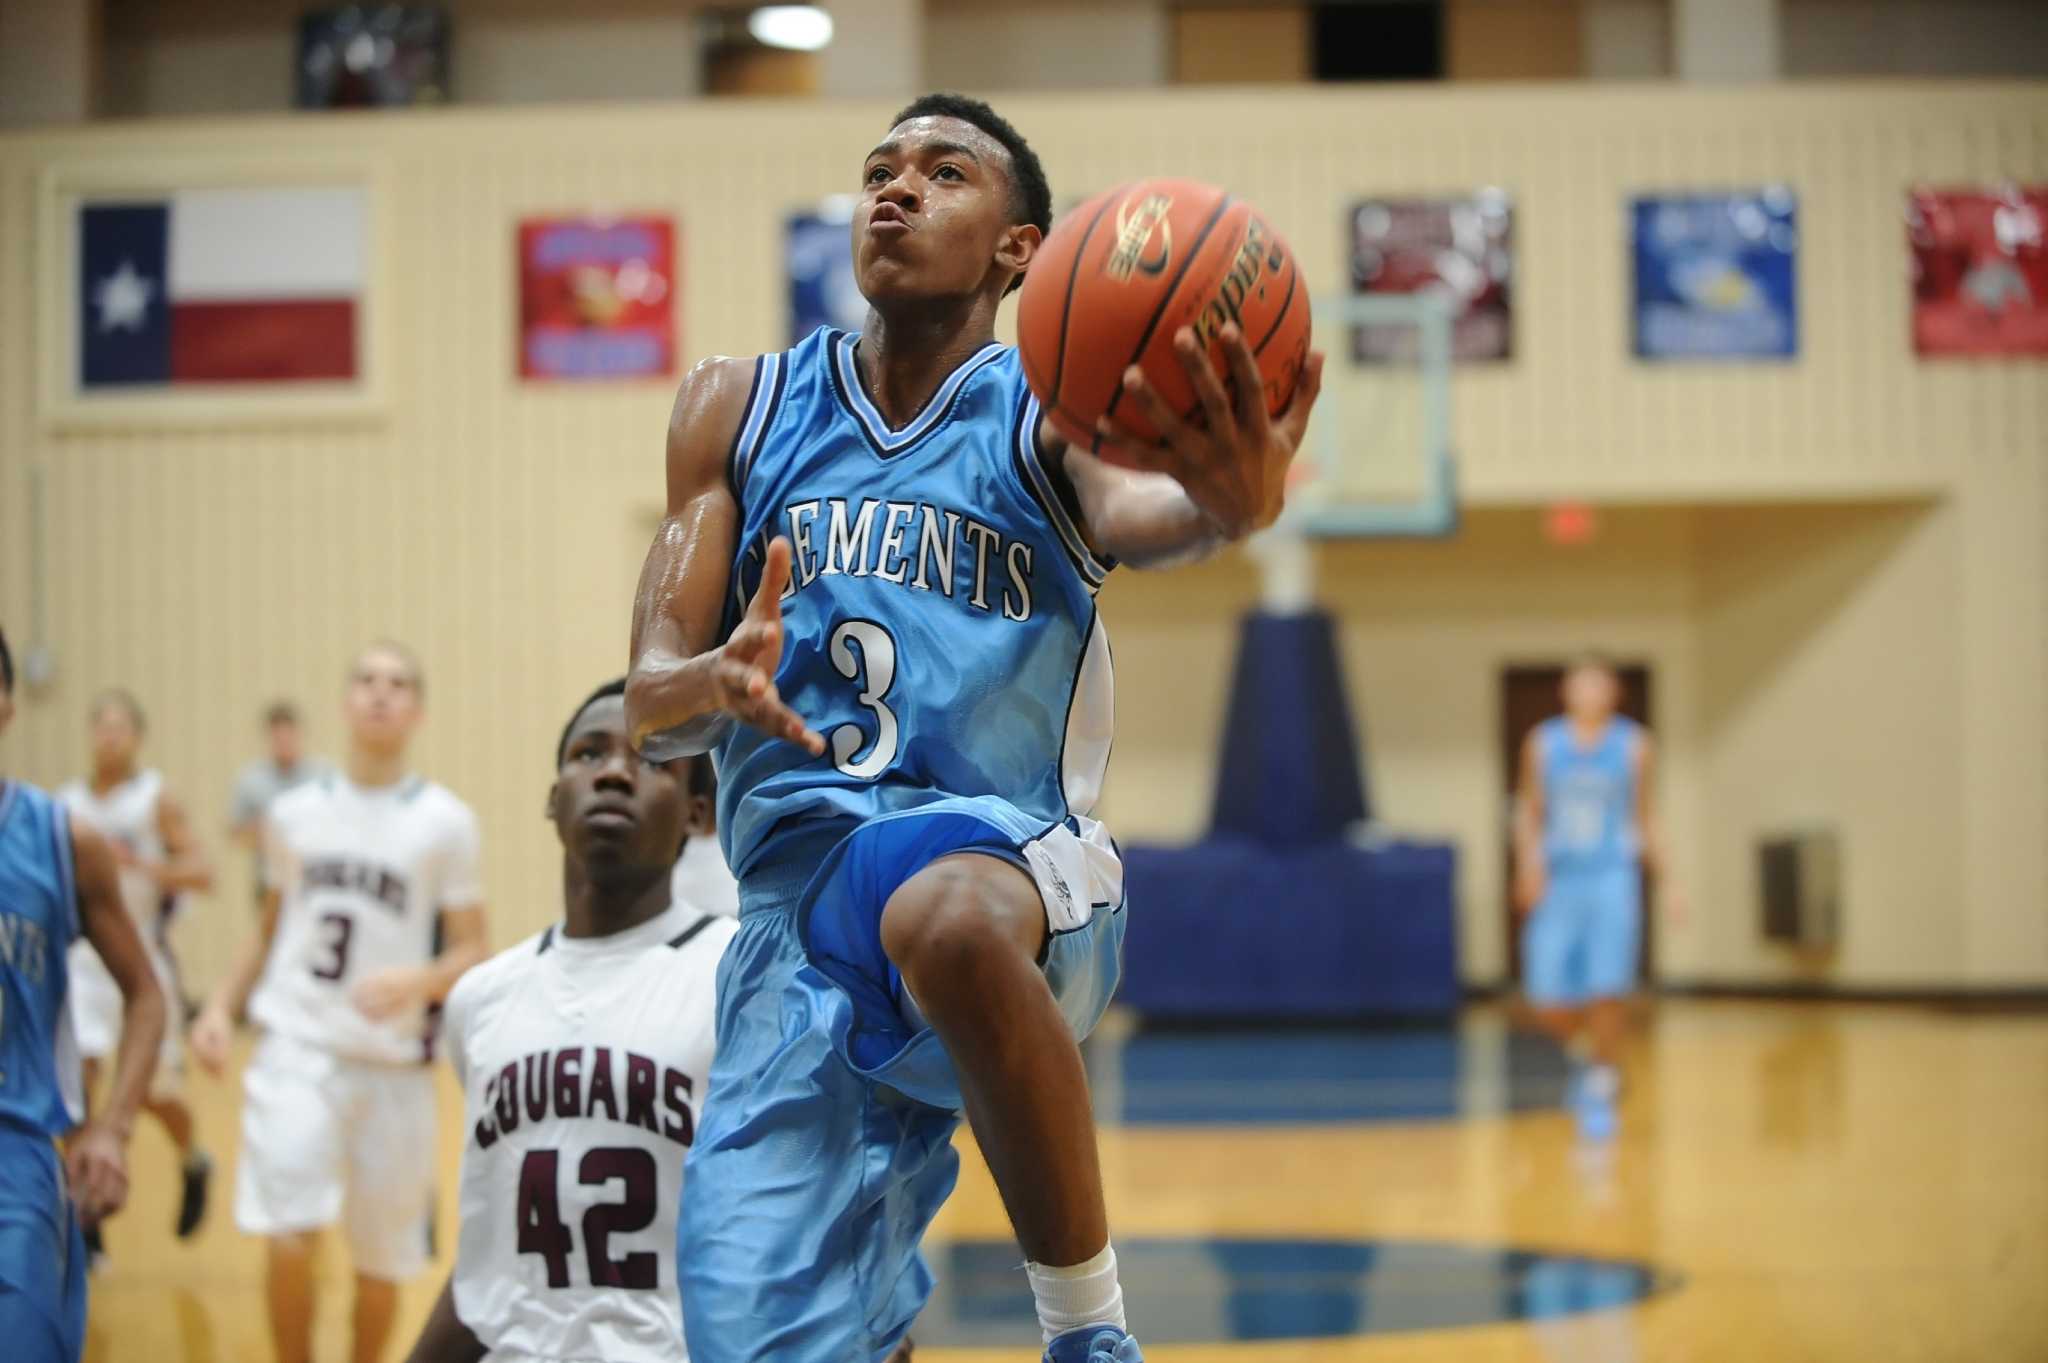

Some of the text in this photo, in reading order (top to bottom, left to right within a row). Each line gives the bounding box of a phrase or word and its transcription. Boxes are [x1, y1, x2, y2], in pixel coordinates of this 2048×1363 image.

[829, 618, 900, 781] 3
[311, 912, 353, 982] 3
[475, 1046, 695, 1149] COUGARS
[516, 1147, 659, 1290] 42
